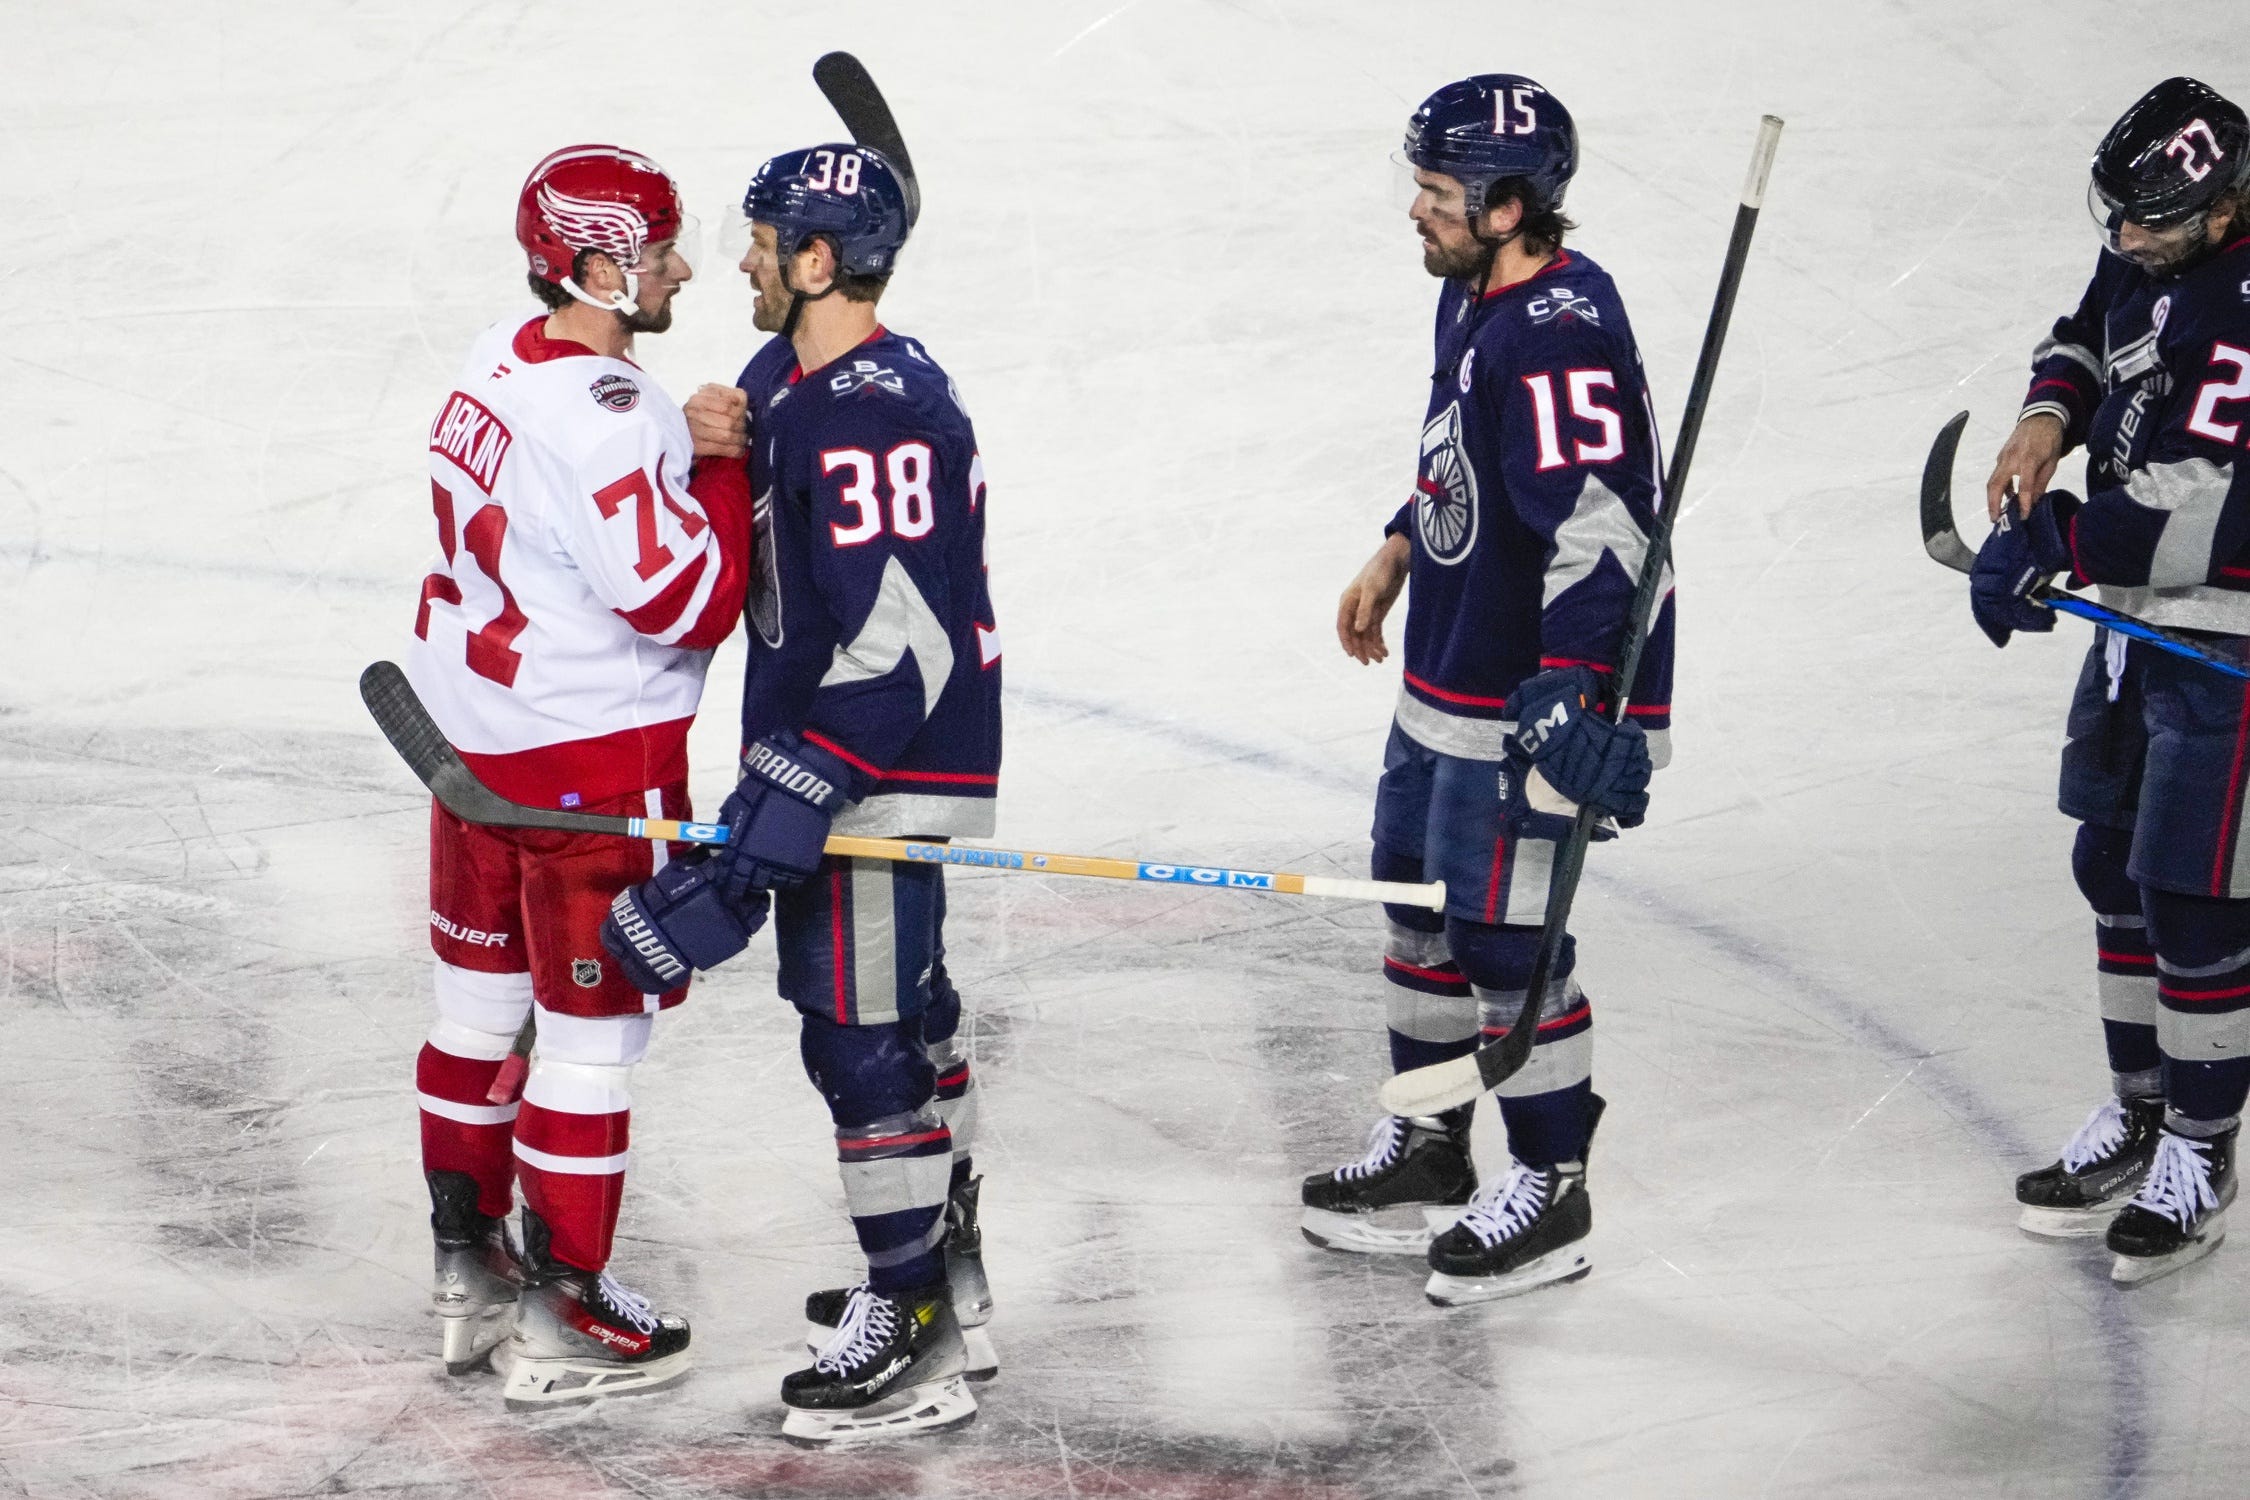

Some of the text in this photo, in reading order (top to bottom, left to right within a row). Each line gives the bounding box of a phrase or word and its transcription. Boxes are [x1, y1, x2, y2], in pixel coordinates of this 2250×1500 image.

[1493, 89, 1536, 135] 15
[808, 150, 862, 195] 38
[2166, 118, 2225, 182] 27
[1522, 368, 1625, 473] 15
[2186, 340, 2250, 452] 2
[430, 396, 508, 488] LARKIN
[820, 440, 934, 548] 38
[1518, 701, 1569, 755] CM
[743, 742, 834, 806] ARRIOR
[905, 844, 1024, 869] COLUMBUS
[1145, 863, 1269, 888] CCM
[611, 887, 687, 981] WARRIO
